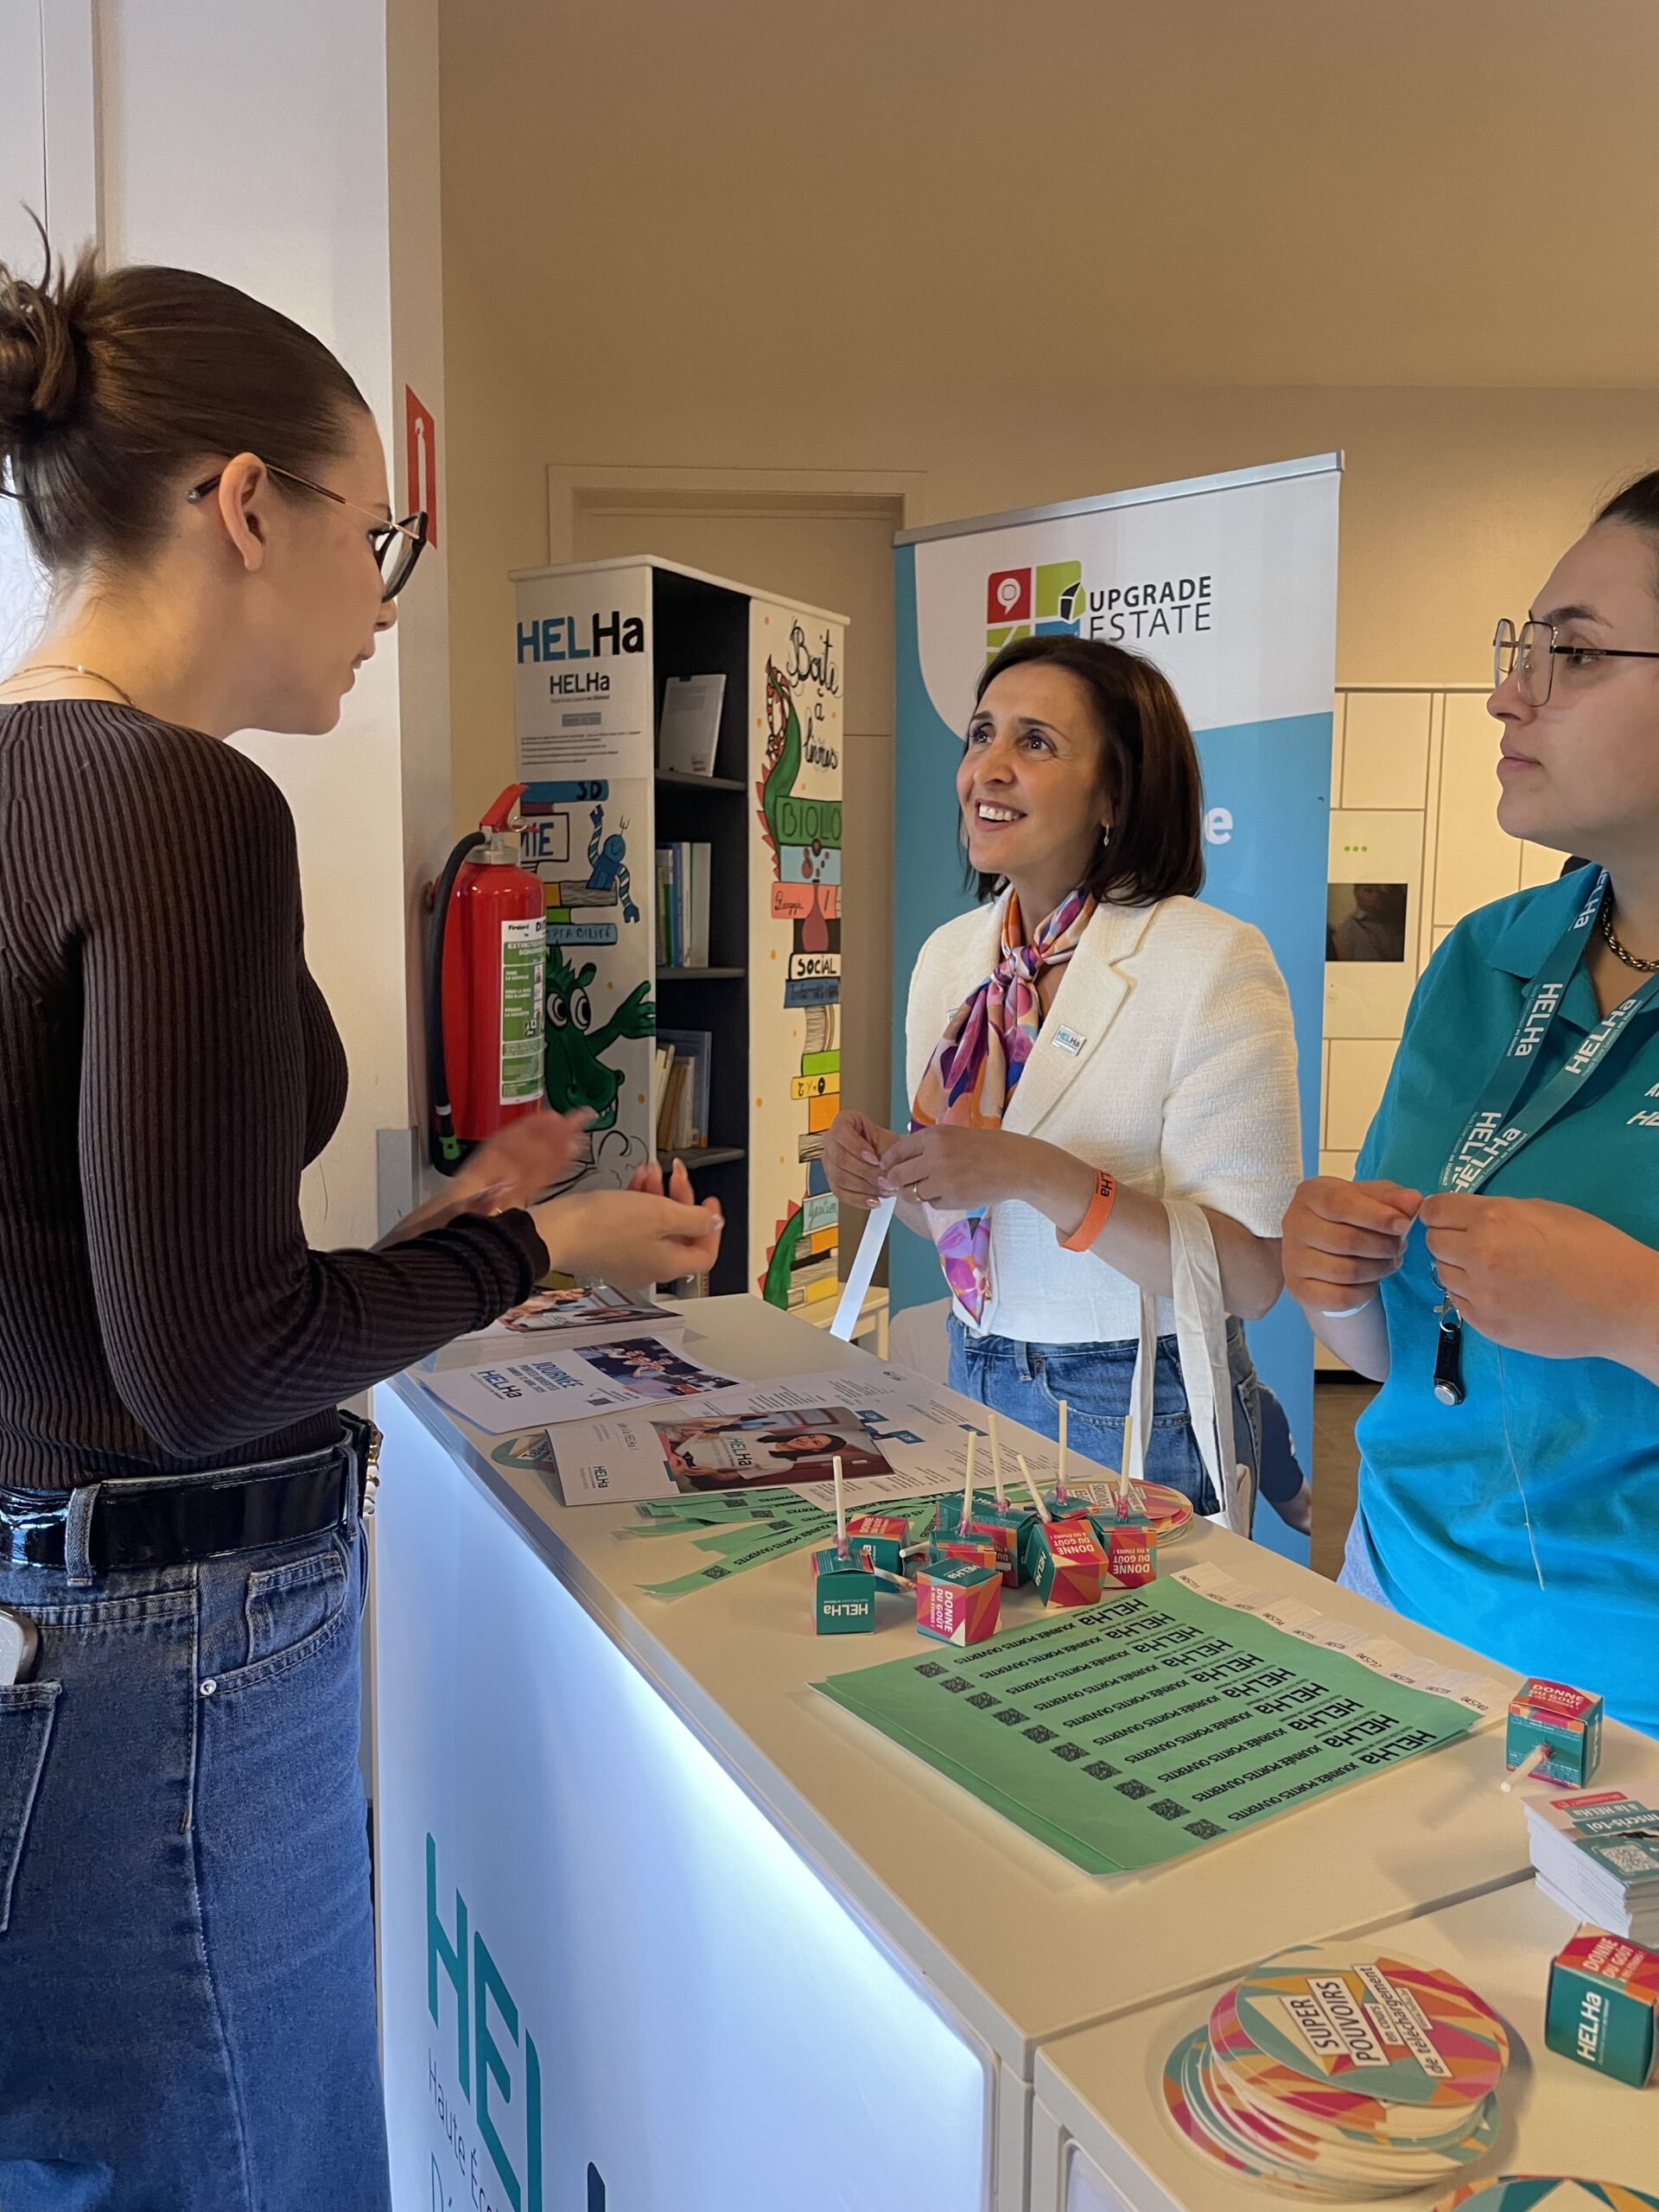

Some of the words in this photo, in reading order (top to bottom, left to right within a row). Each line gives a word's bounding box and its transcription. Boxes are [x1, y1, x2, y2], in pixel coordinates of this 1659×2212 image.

[1089, 575, 1211, 613] UPGRADE
[1089, 601, 1211, 642] ESTATE
[517, 611, 645, 664] HELHa
[550, 672, 610, 695] HELHa
[1515, 983, 1563, 1056] HELHa
[1057, 1029, 1080, 1049] HELHa
[1565, 999, 1637, 1074] HELHa
[478, 1370, 523, 1398] HELHa
[594, 1465, 608, 1489] HELHa
[1056, 1544, 1095, 1555] DONNE
[948, 1564, 981, 1580] HELHa
[1113, 1564, 1150, 1574] DONNE
[936, 1588, 944, 1602] DU
[823, 1604, 868, 1617] HELHa
[944, 1591, 953, 1633] DONNE
[1078, 1599, 1148, 1626] HELHa
[1104, 1612, 1176, 1639] HELHa
[1002, 1635, 1038, 1651] PORTES
[1132, 1626, 1205, 1653] HELHa
[954, 1646, 1002, 1665] OUVERTES
[1028, 1649, 1065, 1665] PORTES
[1160, 1639, 1234, 1668] HELHa
[979, 1659, 1029, 1679] OUVERTES
[1055, 1662, 1091, 1679] PORTES
[1190, 1653, 1265, 1683] HELHa
[1006, 1675, 1056, 1695] OUVERTES
[1083, 1678, 1121, 1694] PORTES
[1221, 1668, 1298, 1698] HELHa
[1533, 1684, 1584, 1702] DONNE
[1033, 1689, 1084, 1712] OUVERTES
[1115, 1694, 1151, 1711] PORTES
[1253, 1682, 1330, 1714] HELHa
[1063, 1706, 1116, 1728] OUVERTES
[1142, 1709, 1182, 1728] PORTES
[1287, 1698, 1364, 1731] HELHa
[1093, 1724, 1145, 1745] OUVERTES
[1174, 1726, 1213, 1745] PORTES
[1322, 1713, 1400, 1748] HELHa
[1124, 1741, 1177, 1764] OUVERTES
[1207, 1744, 1247, 1763] PORTES
[1358, 1729, 1438, 1764] HELHa
[1158, 1759, 1211, 1783] OUVERTES
[1241, 1759, 1283, 1781] PORTES
[1192, 1777, 1246, 1802] OUVERTES
[1279, 1777, 1319, 1802] PORTES
[1227, 1792, 1281, 1821] OUVERTES
[1573, 1806, 1615, 1817] HELHa
[1583, 1937, 1618, 1972] DONNE
[1317, 1981, 1382, 2062] POUVOIRS
[1359, 1967, 1432, 2055] téléchargement
[1370, 2005, 1391, 2029] cours
[1291, 1999, 1339, 2049] SUPER
[1577, 1991, 1602, 2063] HELHa
[1384, 2031, 1398, 2043] en
[1425, 2058, 1444, 2074] de
